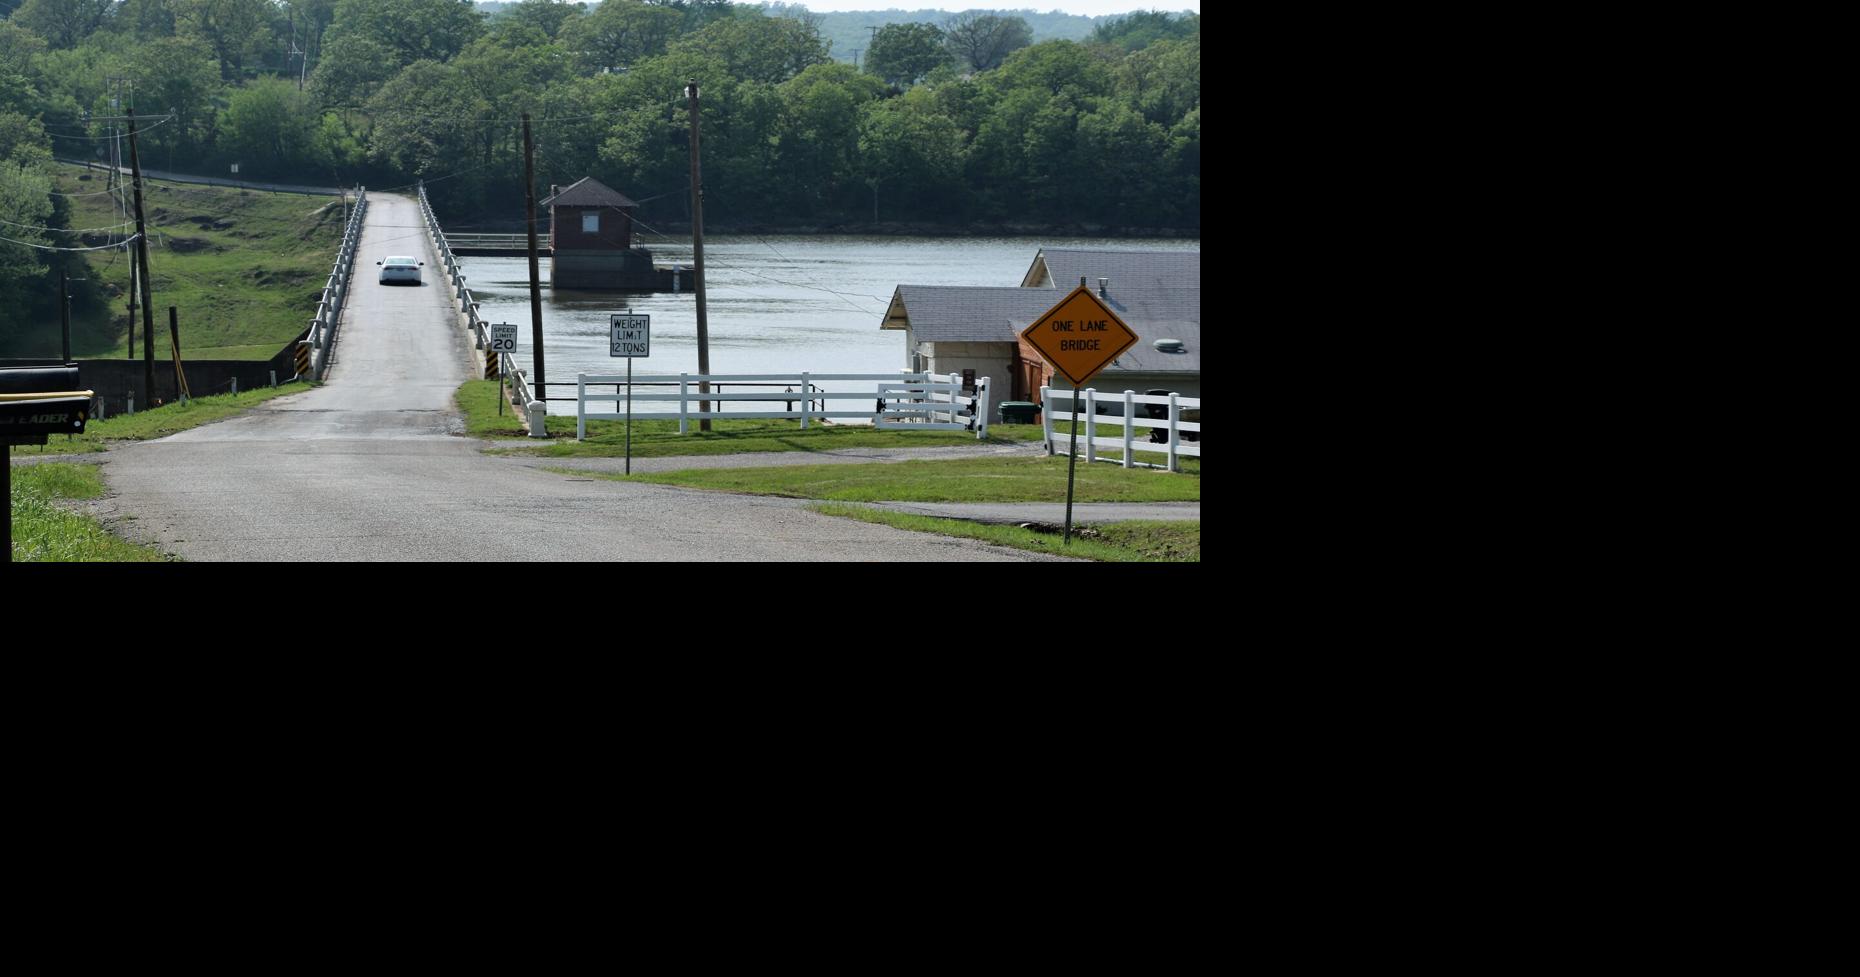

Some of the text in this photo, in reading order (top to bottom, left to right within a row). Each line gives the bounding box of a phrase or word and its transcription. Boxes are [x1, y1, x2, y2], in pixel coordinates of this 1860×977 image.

[613, 318, 647, 329] WEIGHT
[1052, 320, 1108, 332] ONE LANE
[617, 330, 642, 340] LIMIT
[493, 338, 514, 350] 20
[611, 342, 646, 353] 12 TONS
[1060, 340, 1101, 351] BRIDGE
